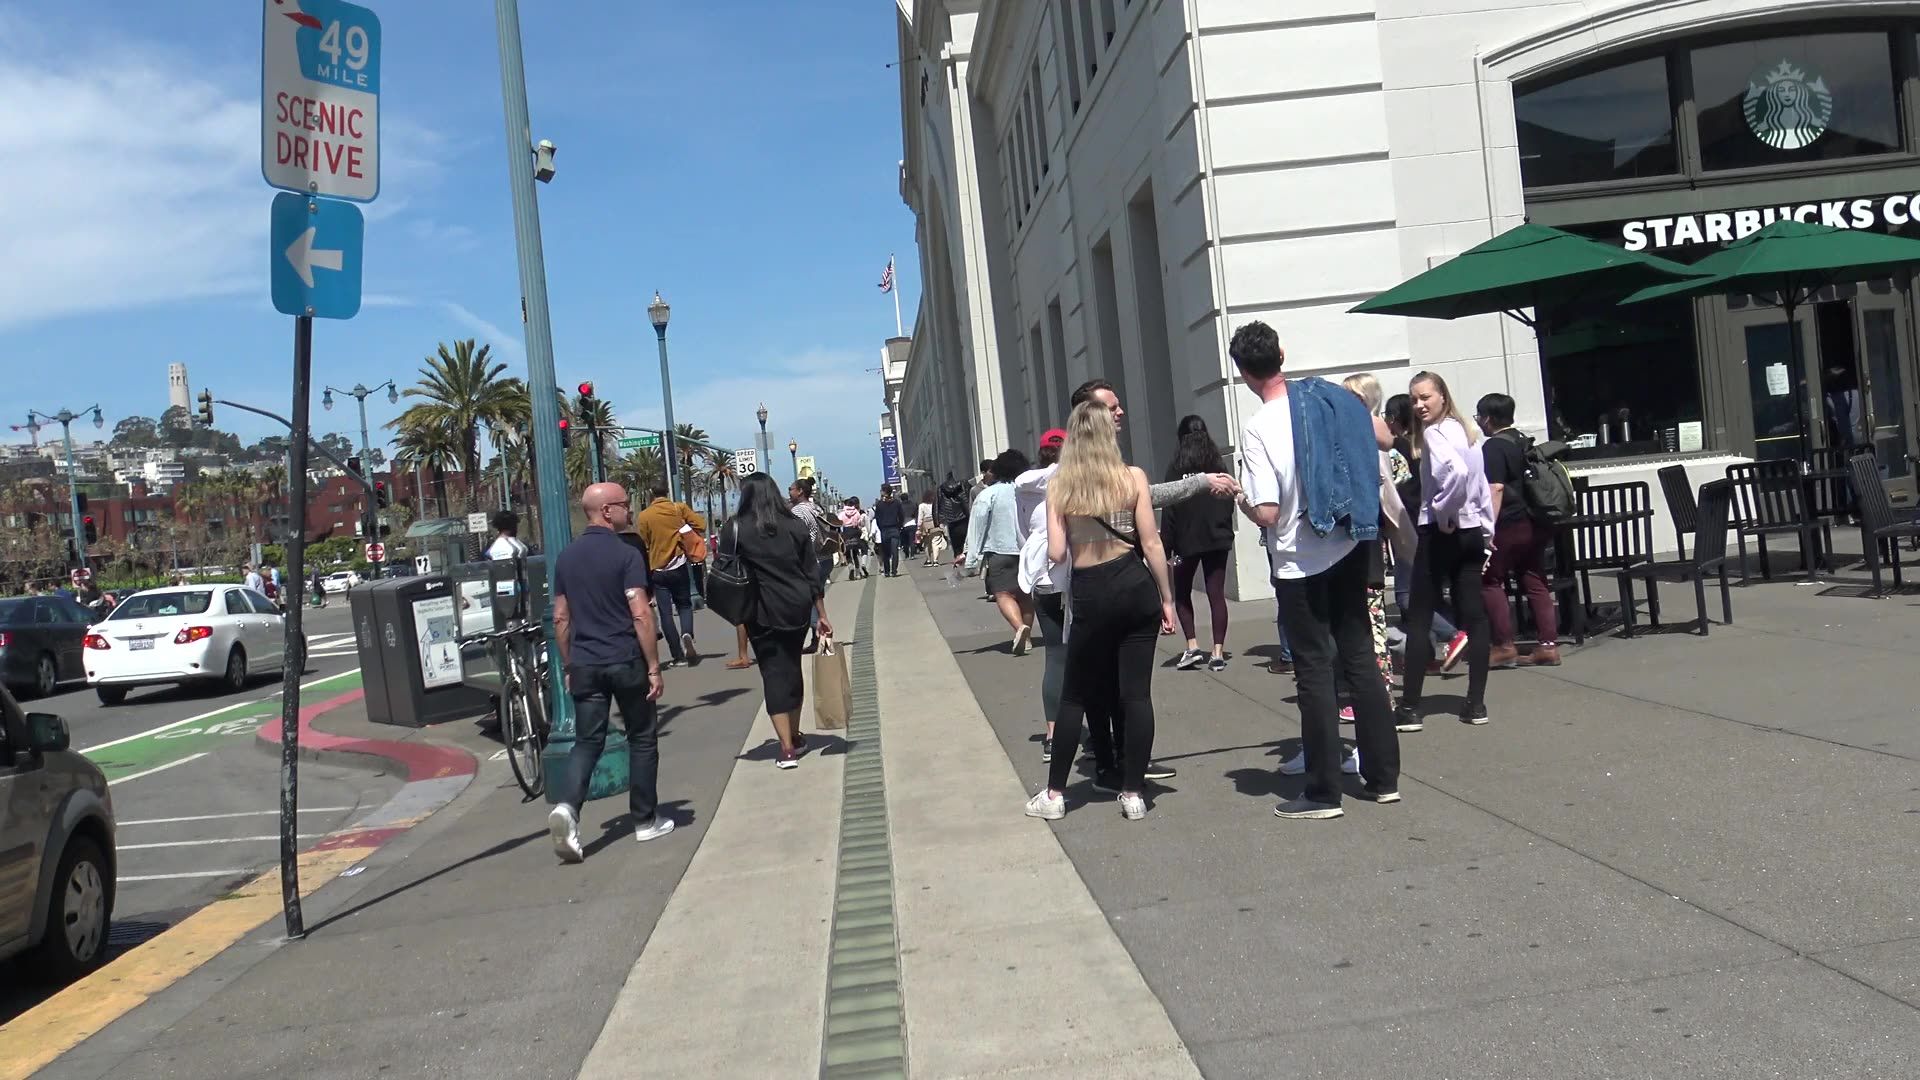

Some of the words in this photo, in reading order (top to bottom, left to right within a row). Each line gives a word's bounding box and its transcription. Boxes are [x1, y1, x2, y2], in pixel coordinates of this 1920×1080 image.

[319, 20, 368, 70] 49
[317, 63, 368, 87] MILE
[276, 92, 363, 139] SCENIC
[277, 132, 363, 178] DRIVE
[619, 439, 650, 447] Washington
[739, 463, 755, 473] 30
